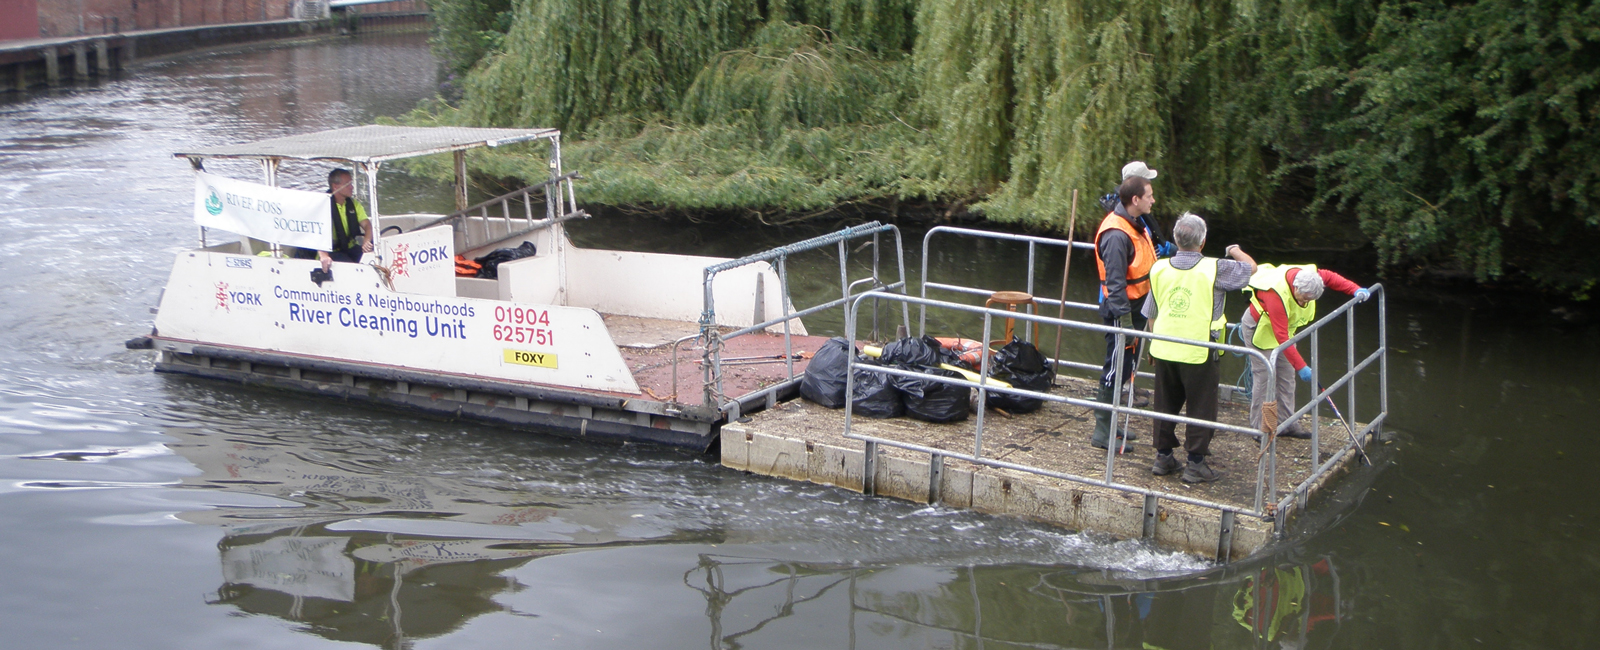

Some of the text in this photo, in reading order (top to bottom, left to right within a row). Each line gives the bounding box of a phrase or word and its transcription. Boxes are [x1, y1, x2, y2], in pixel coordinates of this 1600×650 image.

[257, 200, 283, 216] FOSS
[273, 218, 324, 235] SOCIETY
[409, 245, 449, 266] YORK
[228, 291, 263, 306] YORK
[274, 285, 476, 318] Communities & Neighbourhoods
[289, 302, 467, 340] River Cleaning Unit
[494, 305, 550, 327] 01904
[493, 324, 554, 346] 625751
[514, 351, 545, 364] FOXY
